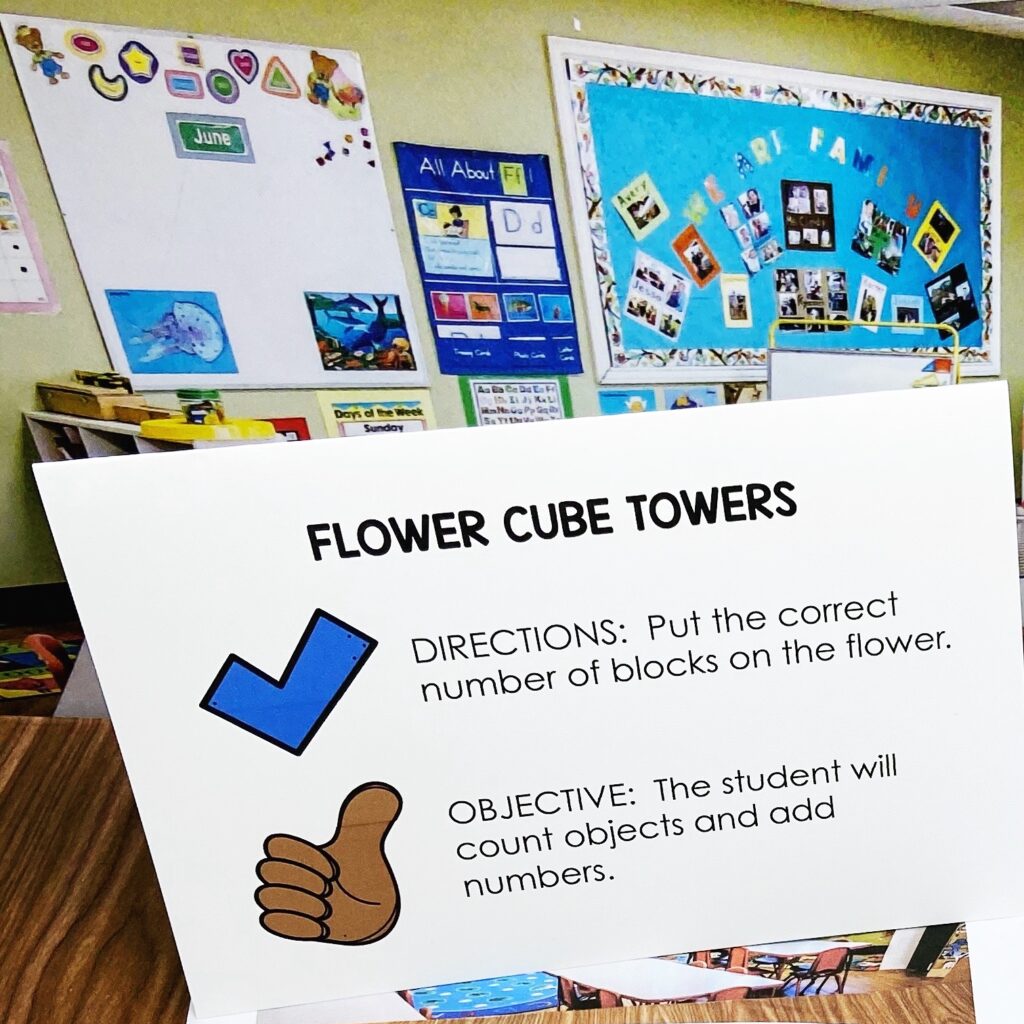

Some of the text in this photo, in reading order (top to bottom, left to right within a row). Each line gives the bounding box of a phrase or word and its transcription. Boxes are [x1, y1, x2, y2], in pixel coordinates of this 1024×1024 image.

[193, 127, 232, 146] June
[419, 157, 446, 176] All
[451, 160, 495, 180] About
[333, 407, 424, 420] Days of the Week
[363, 422, 404, 433] Sunday
[307, 481, 796, 561] FLOWER CUBE TOWERS
[411, 590, 898, 664] DIRECTIONS: Put the correct
[421, 630, 951, 702] number of blocks on the flower.
[448, 753, 897, 825] OBJECTIVE: The student will
[456, 795, 835, 861] count objects and add
[463, 864, 615, 898] numbers.
